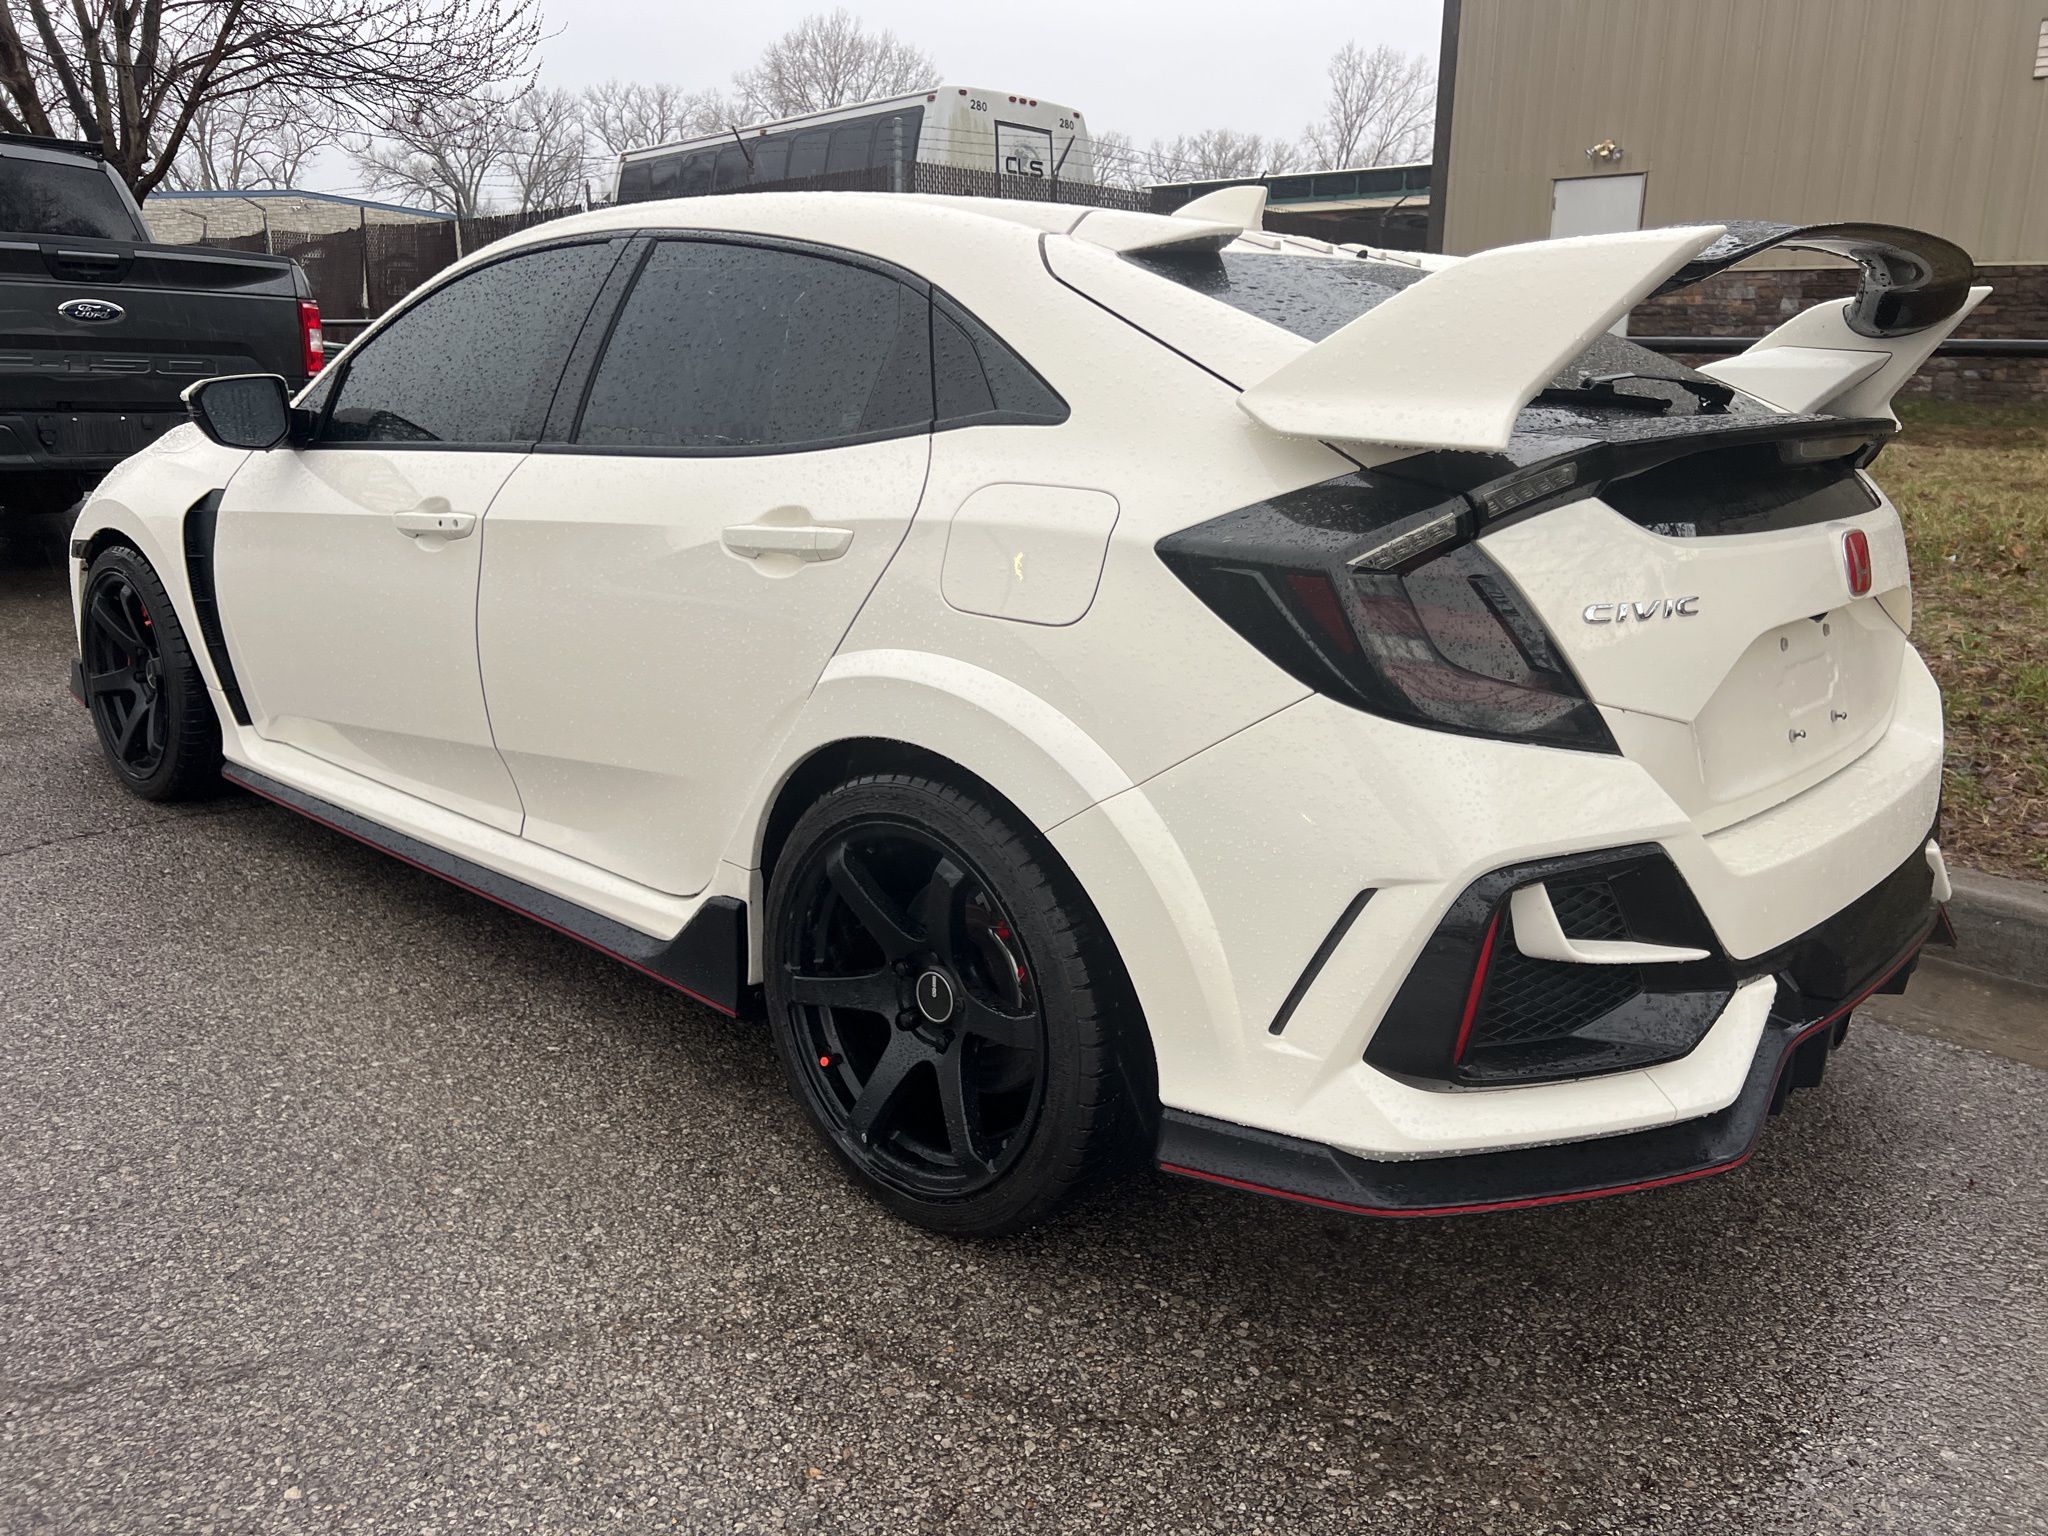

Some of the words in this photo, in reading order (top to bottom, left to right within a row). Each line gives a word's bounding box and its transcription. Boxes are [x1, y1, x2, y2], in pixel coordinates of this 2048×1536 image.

[970, 99, 988, 112] 280
[1059, 118, 1075, 130] 280
[1005, 156, 1044, 178] CLS
[74, 303, 111, 319] Ford
[1582, 596, 1700, 624] CIVIC
